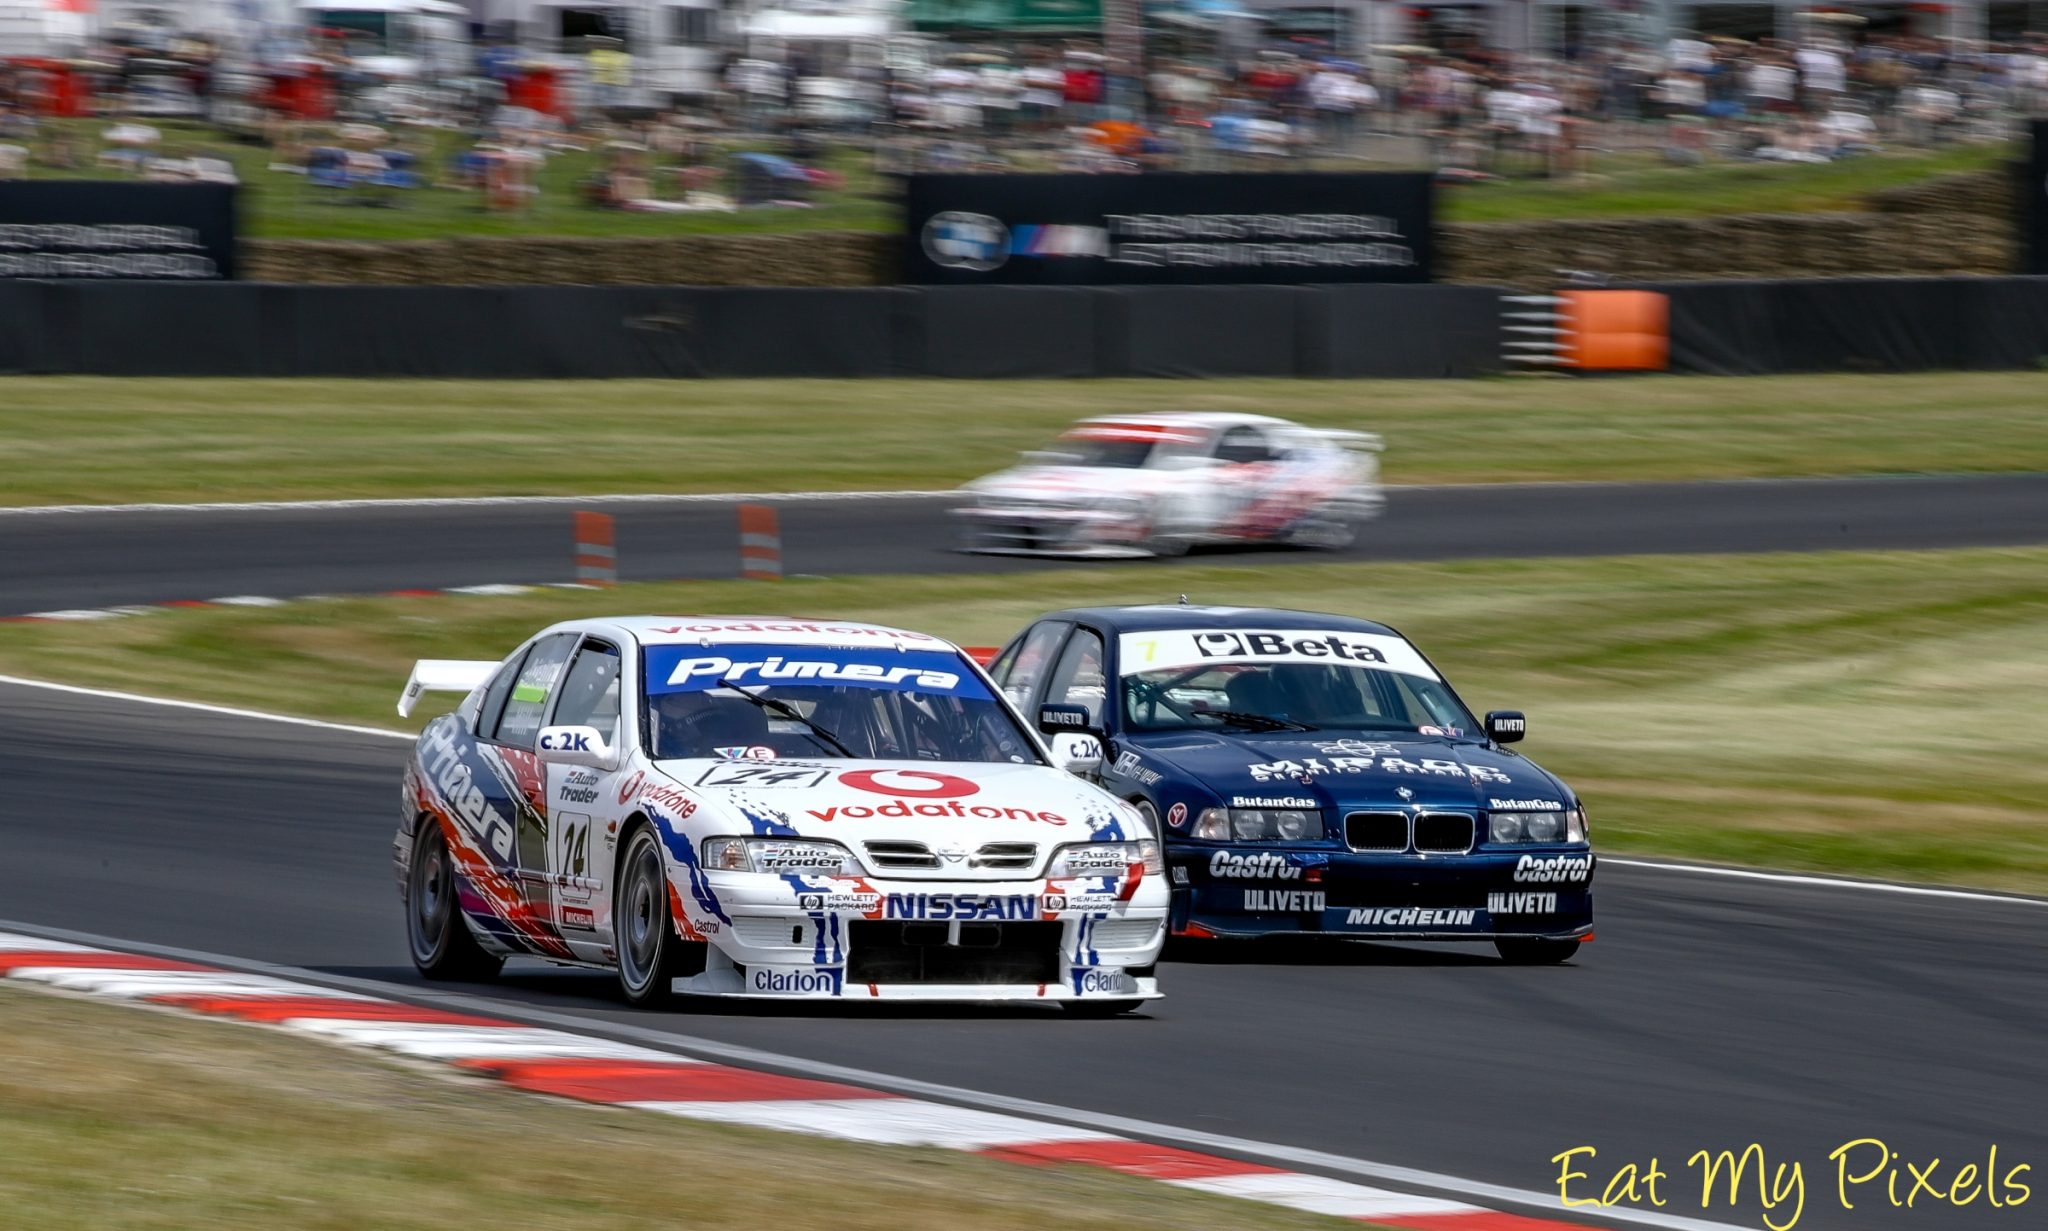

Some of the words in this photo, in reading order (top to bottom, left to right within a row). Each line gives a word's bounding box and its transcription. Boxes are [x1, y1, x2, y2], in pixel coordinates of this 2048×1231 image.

[649, 622, 934, 642] vodafone
[1250, 632, 1388, 665] Beta
[667, 656, 960, 689] Primera
[1042, 710, 1084, 725] ULIVETO
[1494, 718, 1524, 732] ULIVETO
[571, 772, 599, 786] Auto
[708, 768, 817, 786] 24
[422, 712, 514, 862] Primera
[560, 786, 600, 803] Trader
[637, 781, 697, 819] vodafone
[1232, 796, 1316, 808] ButanGas
[1490, 798, 1562, 810] ButanGas
[806, 801, 1068, 826] vodafone
[780, 848, 829, 857] Auto
[1078, 850, 1120, 859] Auto
[763, 857, 843, 868] Trader
[1067, 859, 1133, 868] Trader
[1513, 854, 1593, 882] Castrol
[827, 903, 876, 911] PACKARD
[887, 892, 1035, 920] NISSAN
[1244, 889, 1326, 912] ULIVETO
[1487, 892, 1558, 914] ULIVETO
[565, 911, 593, 926] MICHELIN
[1346, 907, 1476, 926] MICHELIN
[694, 919, 720, 934] Castrol
[755, 969, 832, 992] Clarion
